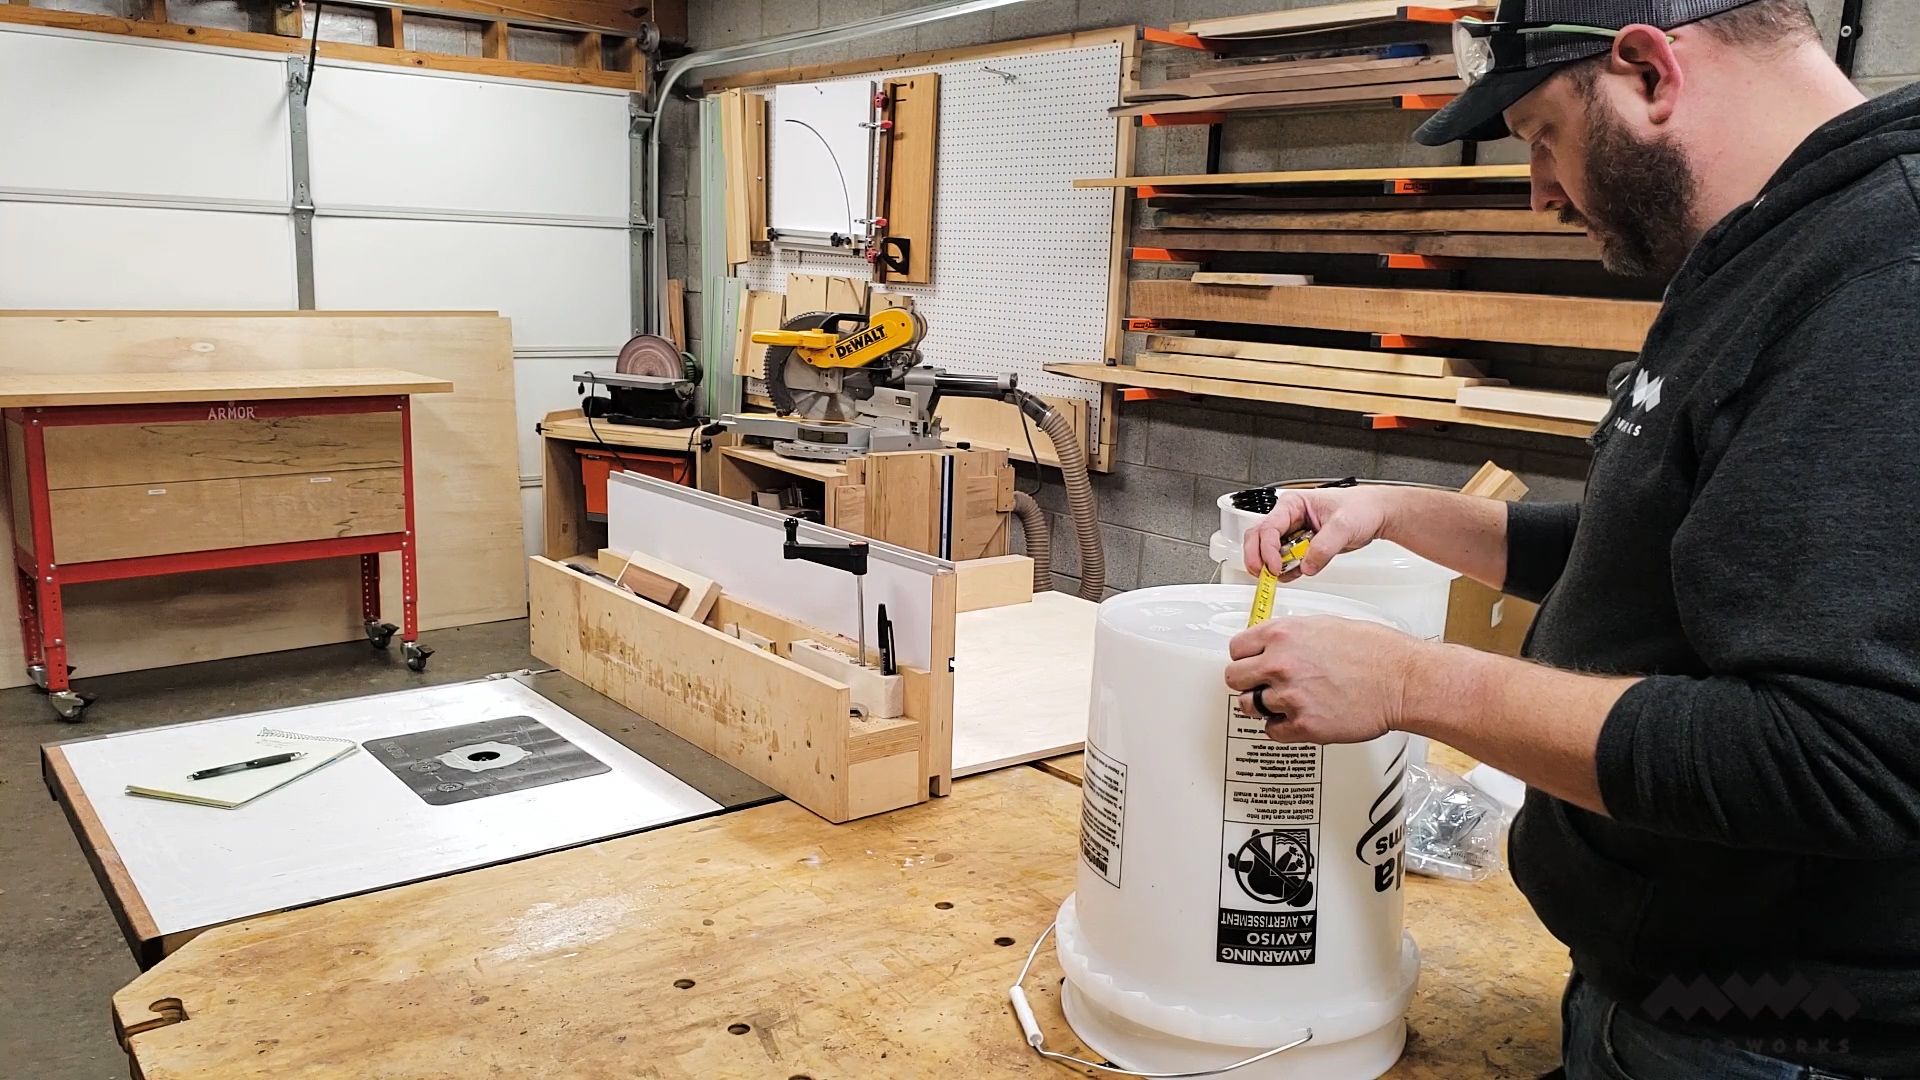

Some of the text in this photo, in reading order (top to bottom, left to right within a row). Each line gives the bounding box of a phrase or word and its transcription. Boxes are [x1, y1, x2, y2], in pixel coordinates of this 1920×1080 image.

[208, 406, 256, 420] ARMOR
[1221, 912, 1299, 927] AVERTISSEMENT
[1247, 932, 1297, 945] AVISO
[1222, 948, 1299, 962] WARNING
